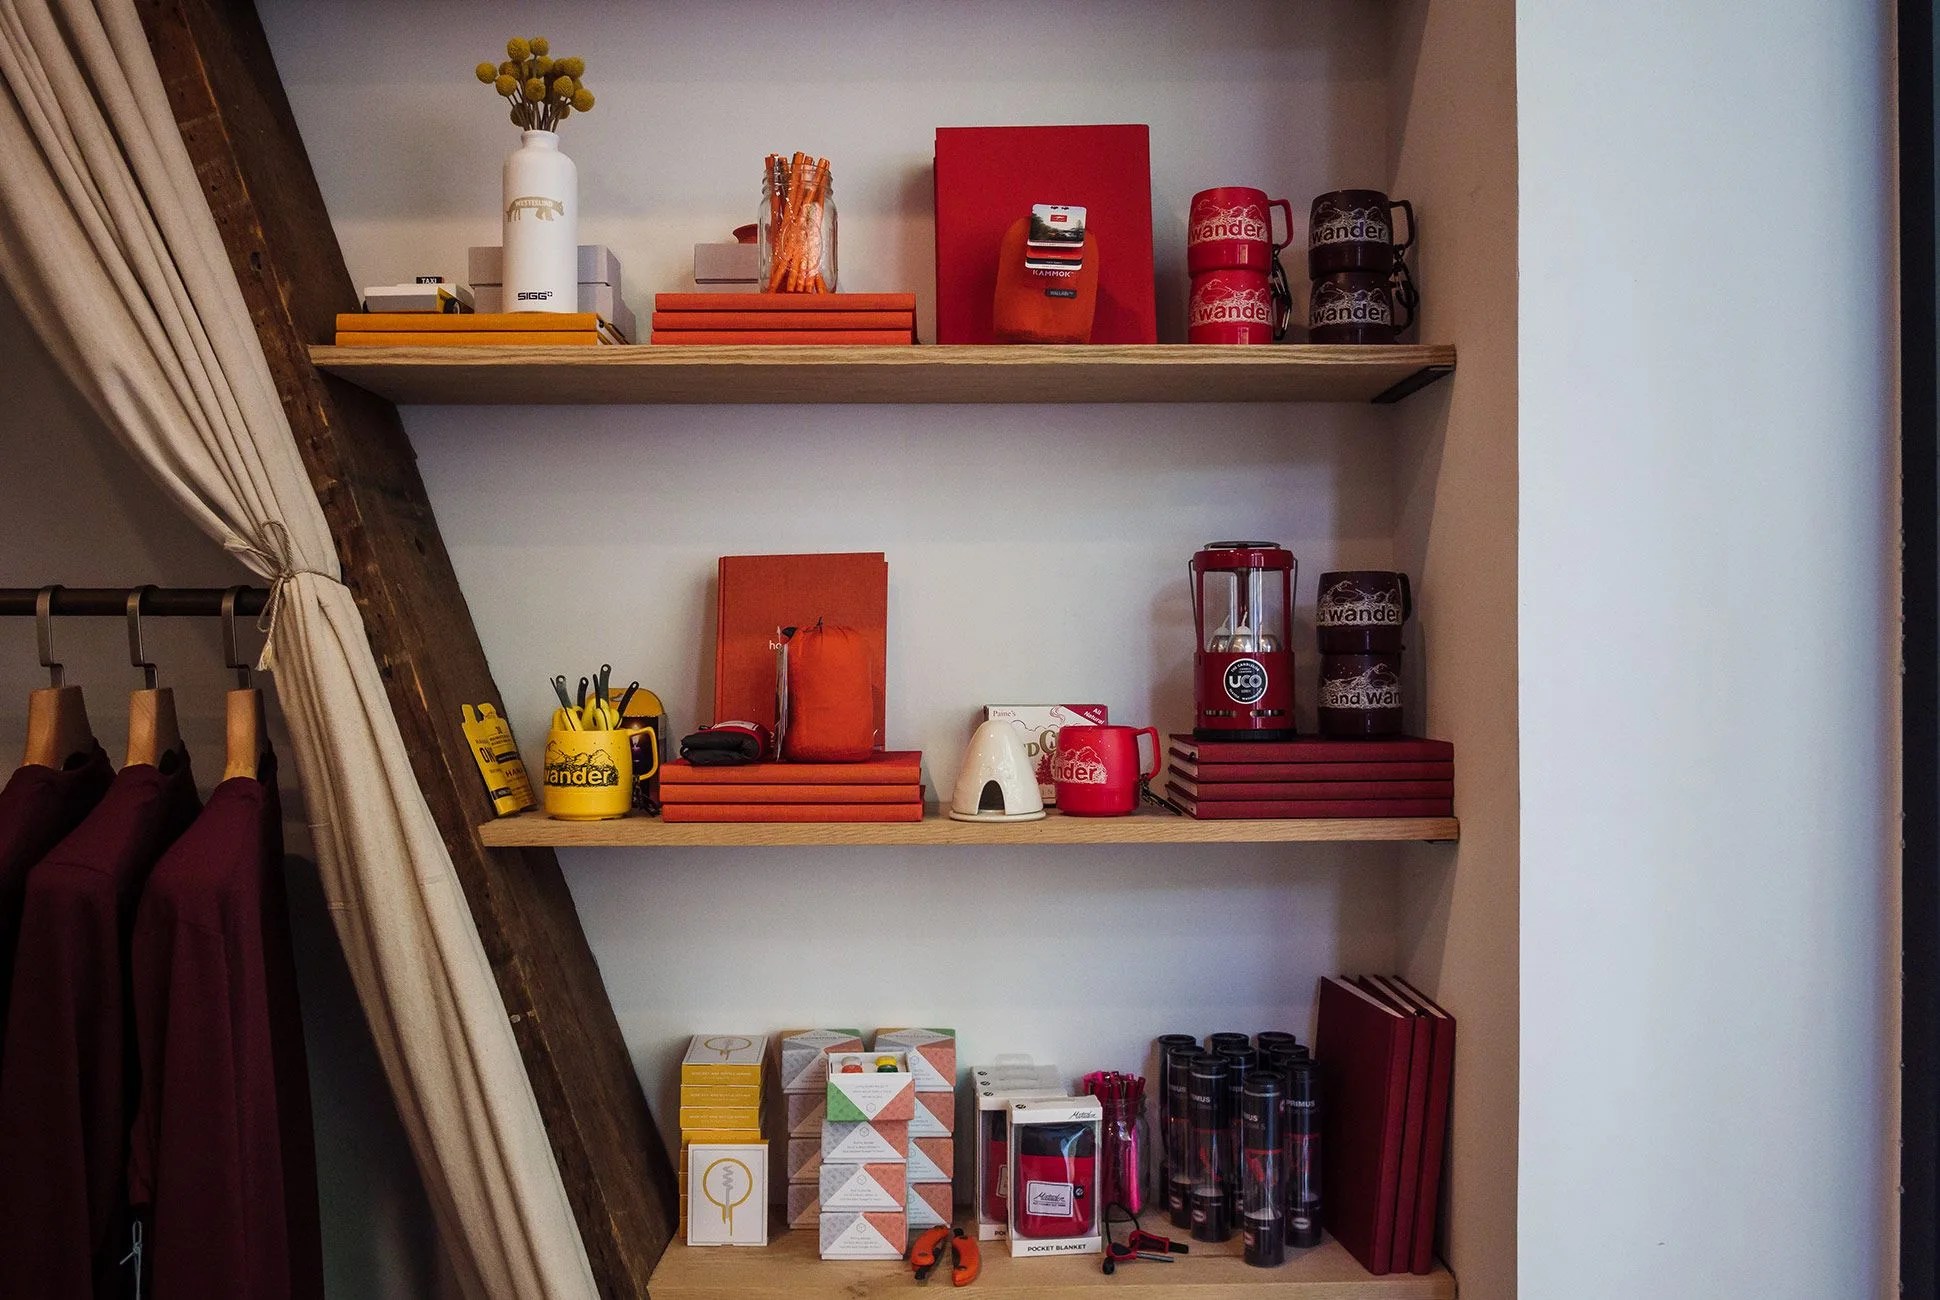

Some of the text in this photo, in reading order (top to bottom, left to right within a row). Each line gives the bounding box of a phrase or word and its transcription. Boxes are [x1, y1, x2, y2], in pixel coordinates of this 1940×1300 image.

[1191, 219, 1262, 242] wander
[1312, 221, 1384, 245] wander
[1032, 269, 1071, 278] KAMMOK
[517, 291, 548, 301] SIGG
[1313, 303, 1388, 323] wander
[1228, 674, 1262, 688] UCO
[1330, 692, 1360, 705] and
[1082, 710, 1105, 726] Natural
[1285, 1099, 1316, 1108] PRIMUS
[1027, 1243, 1087, 1252] POCKET BLANKET
